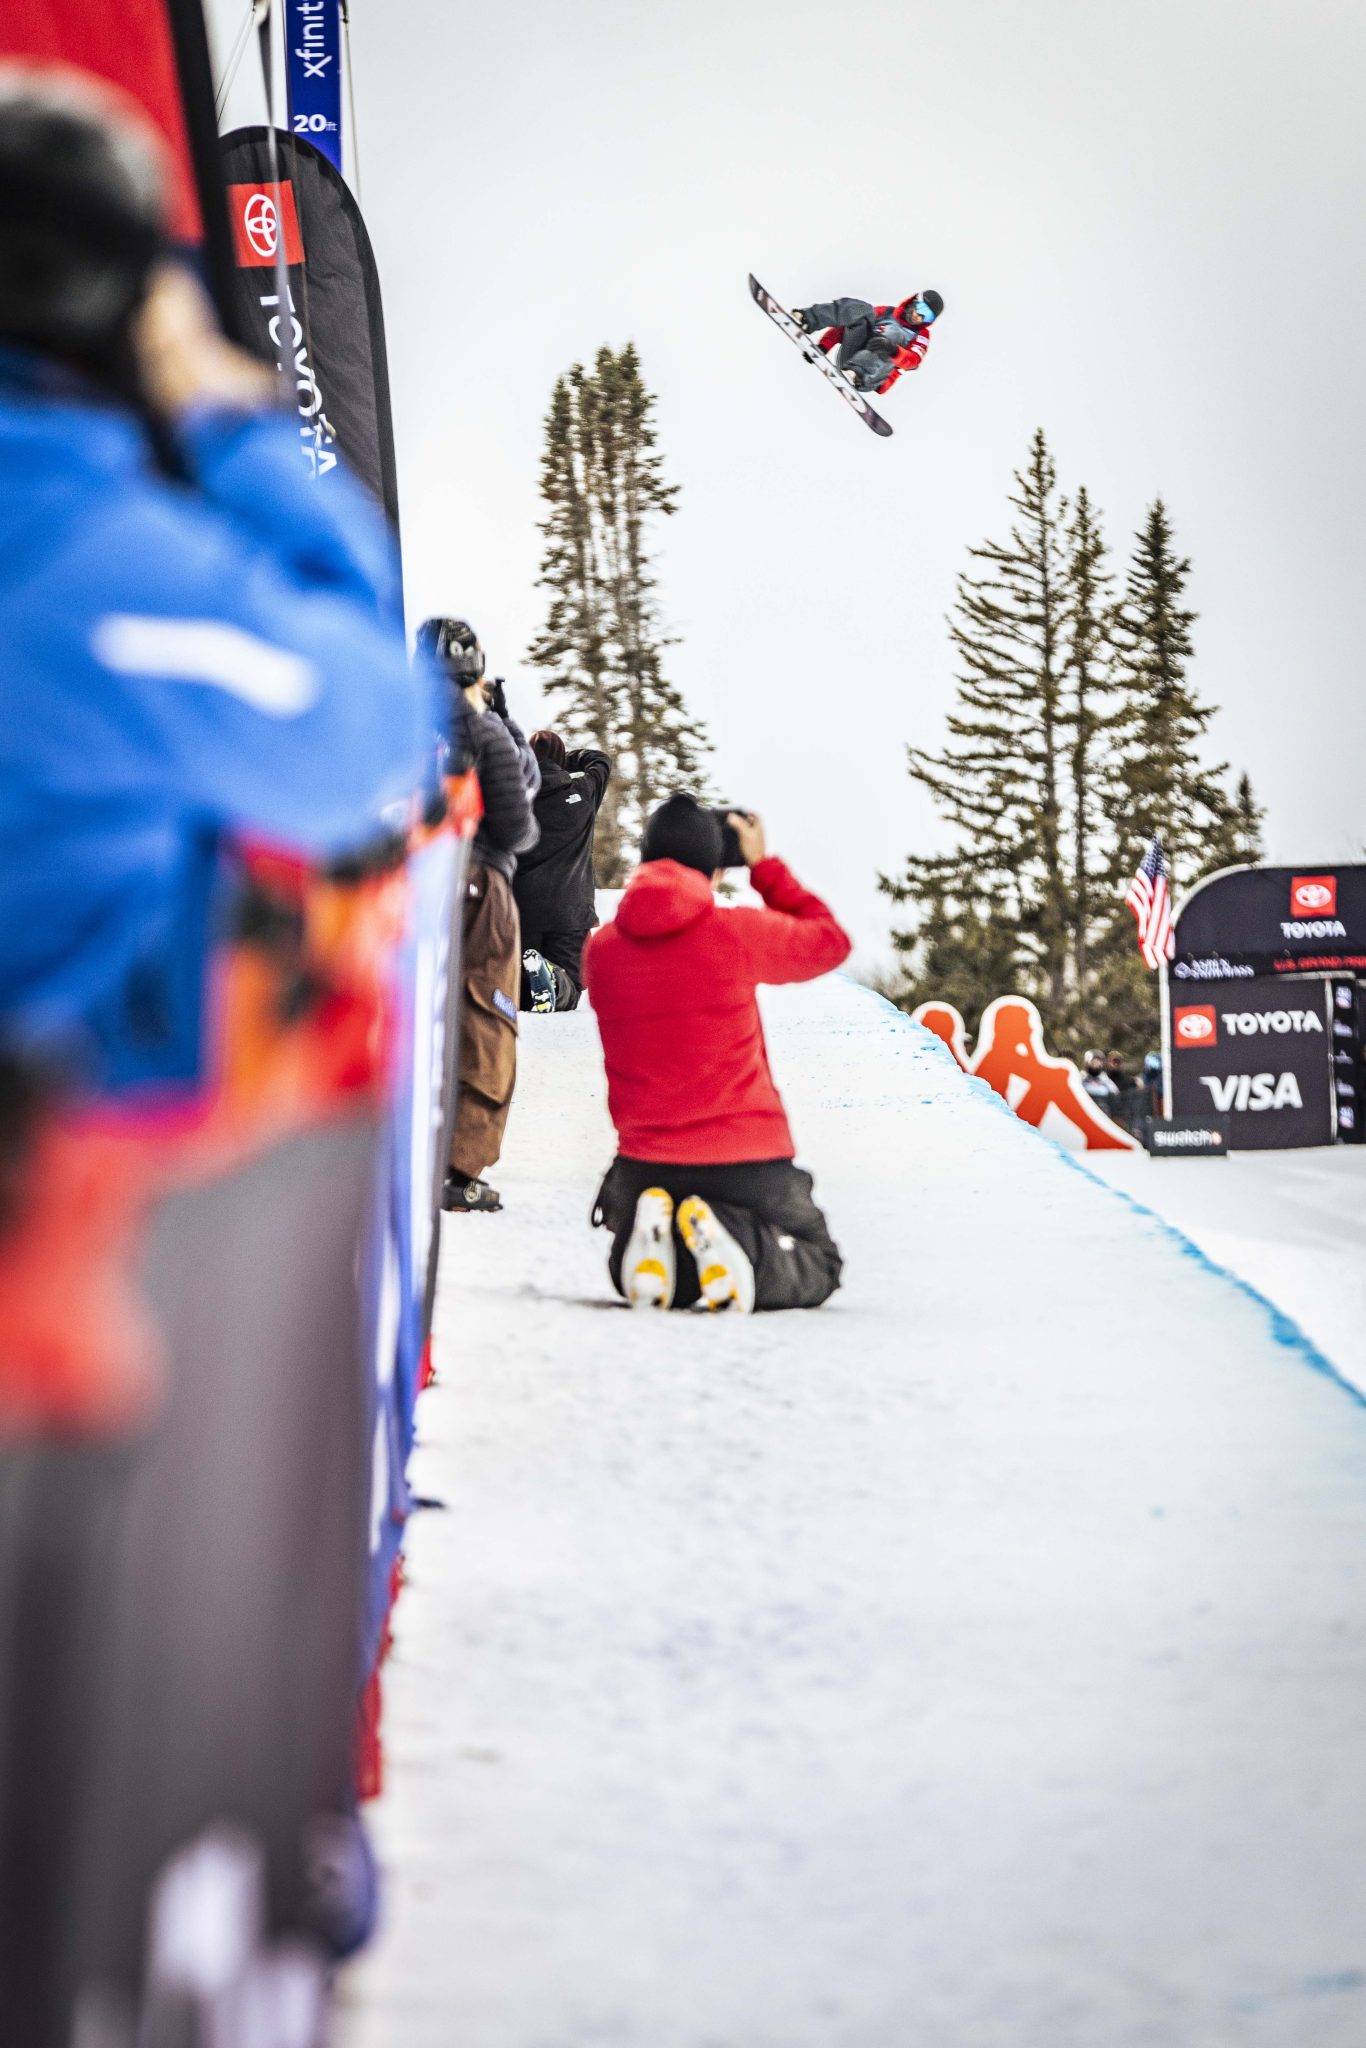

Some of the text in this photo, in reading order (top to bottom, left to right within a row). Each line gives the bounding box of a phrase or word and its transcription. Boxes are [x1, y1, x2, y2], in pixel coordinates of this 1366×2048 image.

[295, 0, 332, 78] xfinit
[1280, 920, 1347, 939] TOYOTA
[1221, 1010, 1324, 1036] TOYOTA
[1200, 1071, 1303, 1112] VISA
